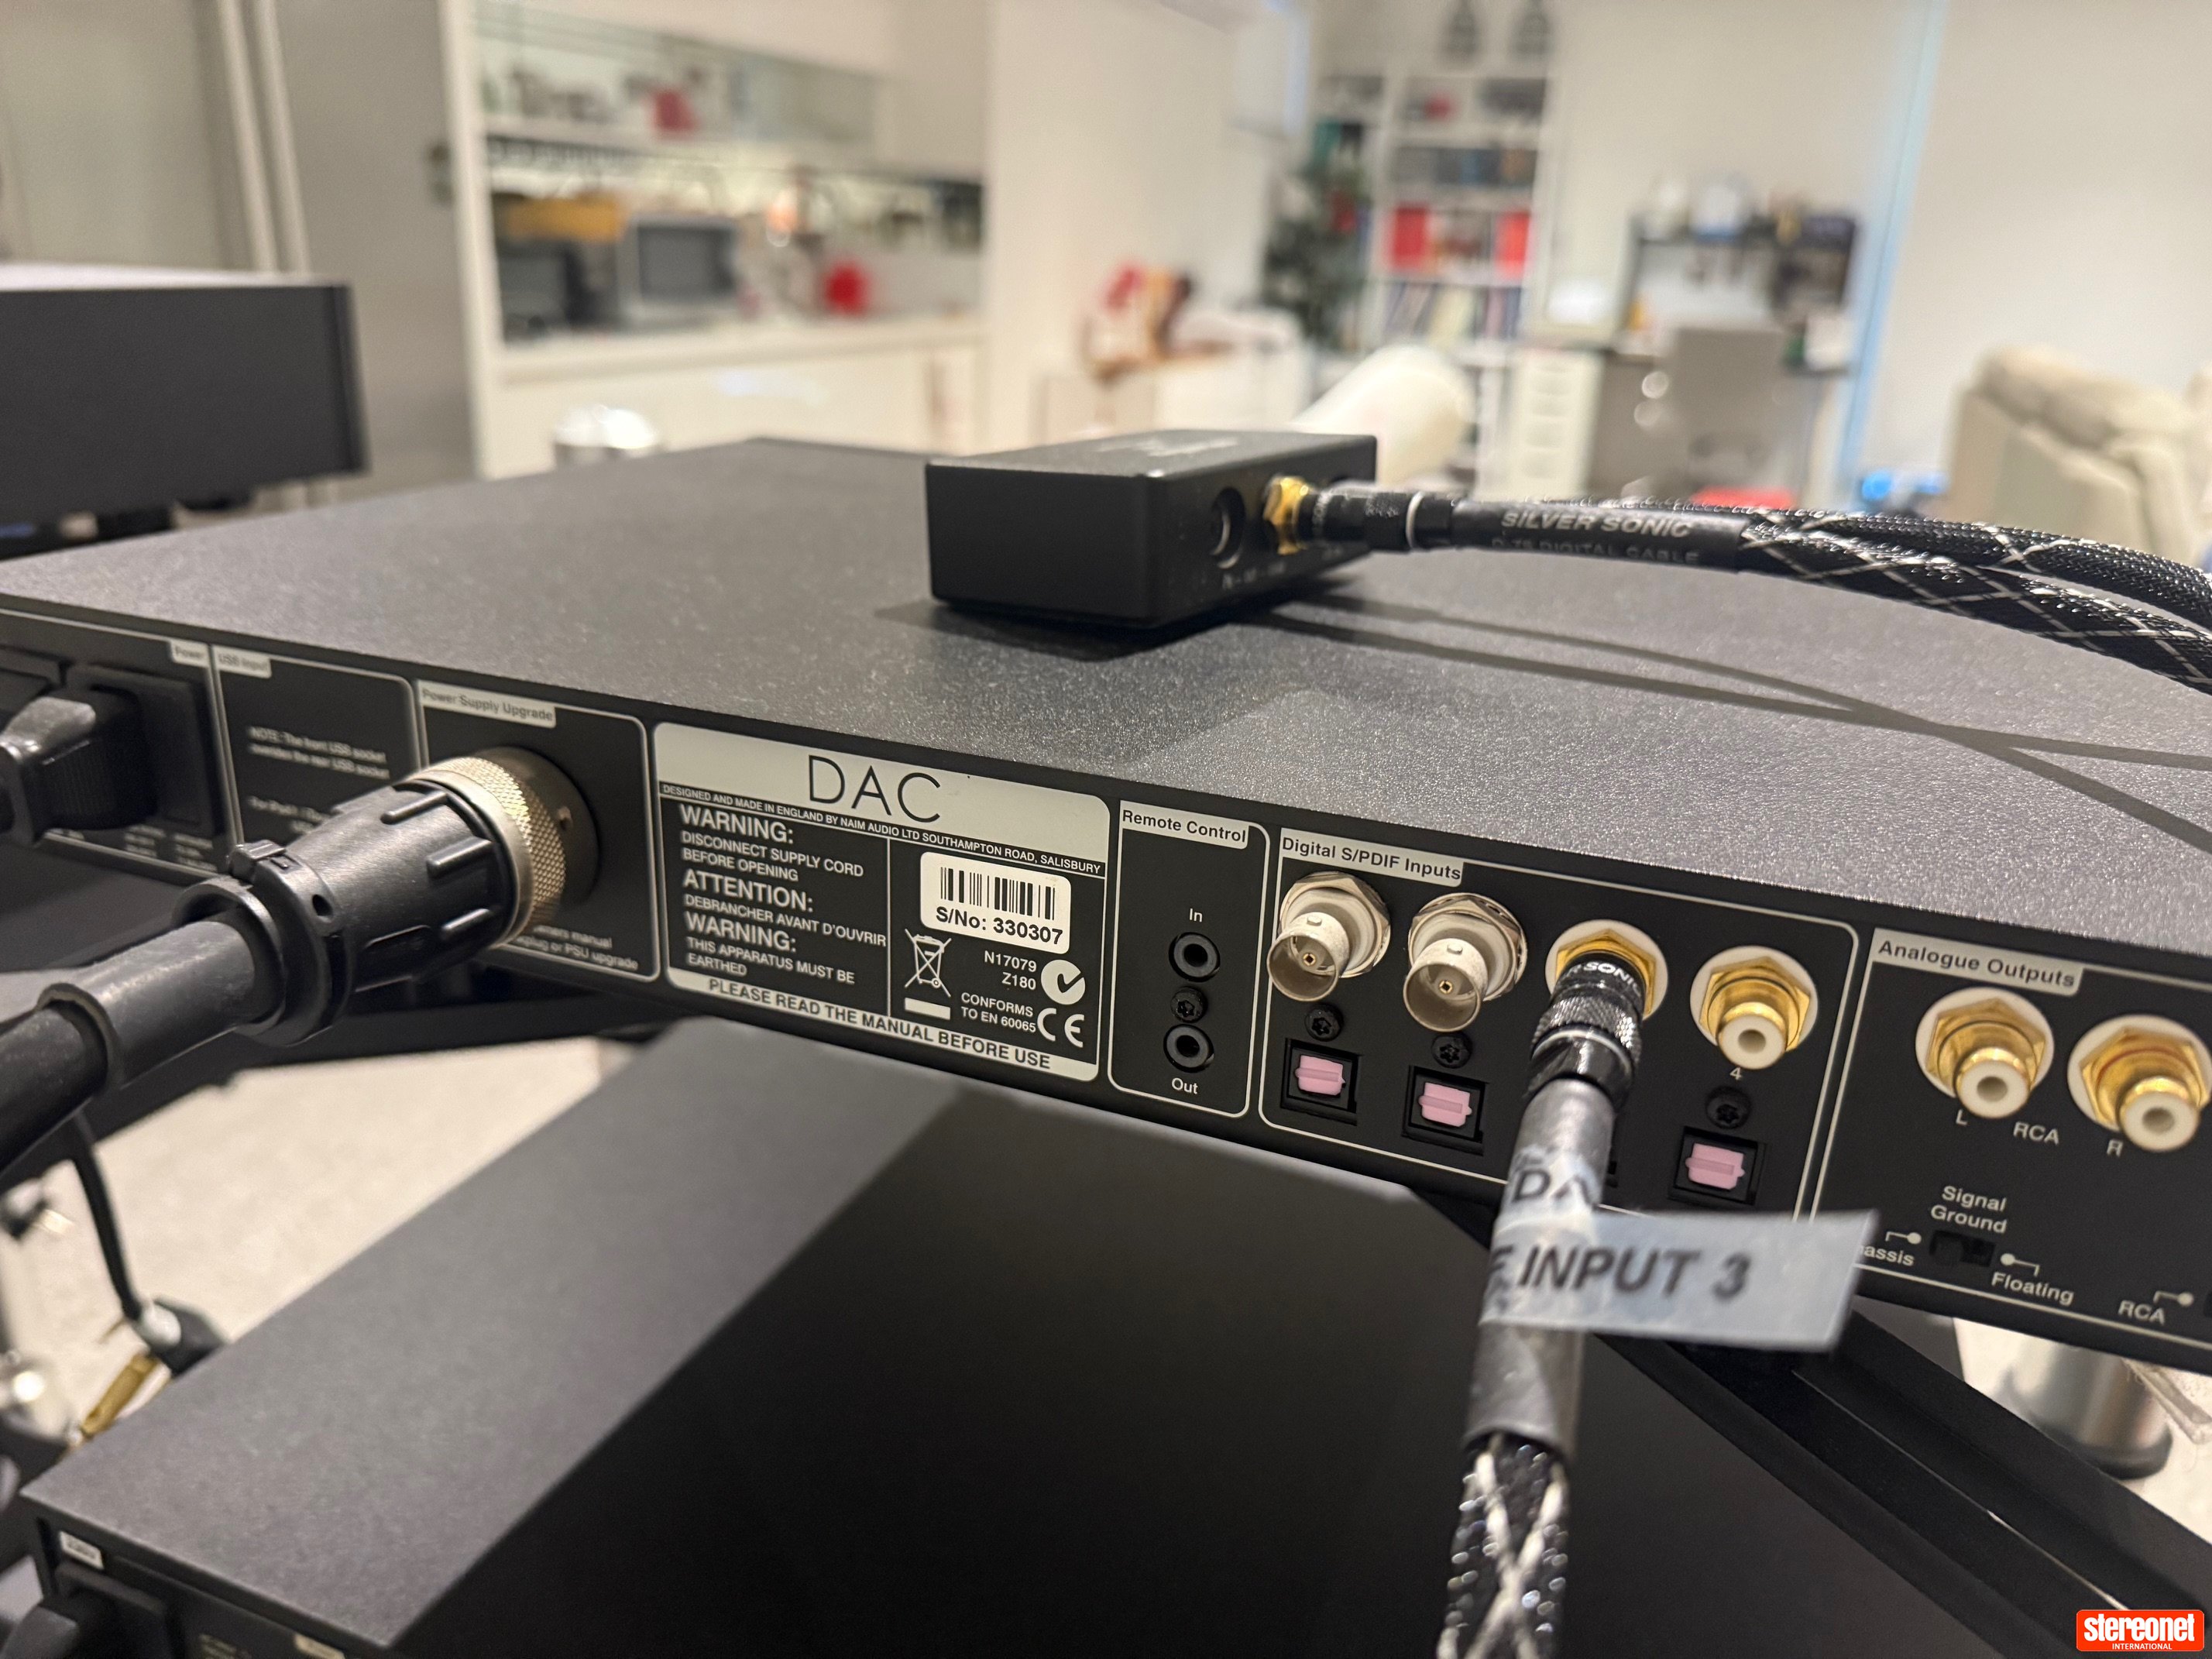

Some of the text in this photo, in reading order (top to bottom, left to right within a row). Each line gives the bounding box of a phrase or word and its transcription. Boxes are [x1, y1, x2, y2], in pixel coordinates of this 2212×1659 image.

[1501, 510, 1692, 538] SILVER SONIC
[1625, 545, 1700, 565] CABLE
[422, 688, 553, 721] Power Supply Upgrade
[808, 754, 941, 823] DAC
[662, 784, 1101, 874] DESIGNED AND MADE IN ENGLAND BY NAIM AUDIO LTD SOUTHAMPTON ROAD, SALISBURY
[679, 803, 794, 844] WARNING:
[1121, 809, 1246, 843] Remote Control
[681, 830, 864, 878] DISCONNECT SUPPLY CORD
[682, 847, 799, 882] BEFORE OPENING
[1282, 836, 1462, 881] Digital S/PDIF Inputs
[682, 868, 813, 912] ATTENTION:
[684, 893, 887, 947] DEBRANCHER AVANT D'OUVRIR
[936, 906, 1063, 945] S/No: 330307
[1189, 908, 1203, 923] In
[684, 911, 796, 952] WARNING:
[565, 943, 589, 959] PSU
[686, 936, 856, 984] THIS APPARATUS MUST BE
[688, 953, 747, 977] EARTHED
[984, 950, 1037, 973] N17079
[1878, 939, 2076, 988] Analogue Outputs
[1001, 971, 1036, 991] Z180
[960, 991, 1034, 1018] CONFORMS
[960, 1006, 1036, 1033] TO EN 60065
[709, 978, 1051, 1070] PLEASE READ THE MANUAL BEFORE USE
[1171, 1077, 1199, 1095] Out
[1729, 1066, 1743, 1080] 4
[1956, 1108, 1968, 1126] L
[2013, 1121, 2060, 1146] RCA
[2106, 1139, 2124, 1159] R
[1942, 1185, 2008, 1213] Signal
[1930, 1204, 2008, 1235] Ground
[1859, 1244, 1915, 1267] assis
[1516, 1245, 1702, 1300] INPUT
[1712, 1250, 1753, 1304] 3
[1991, 1272, 2075, 1307] Floating
[2118, 1300, 2166, 1325] RCA
